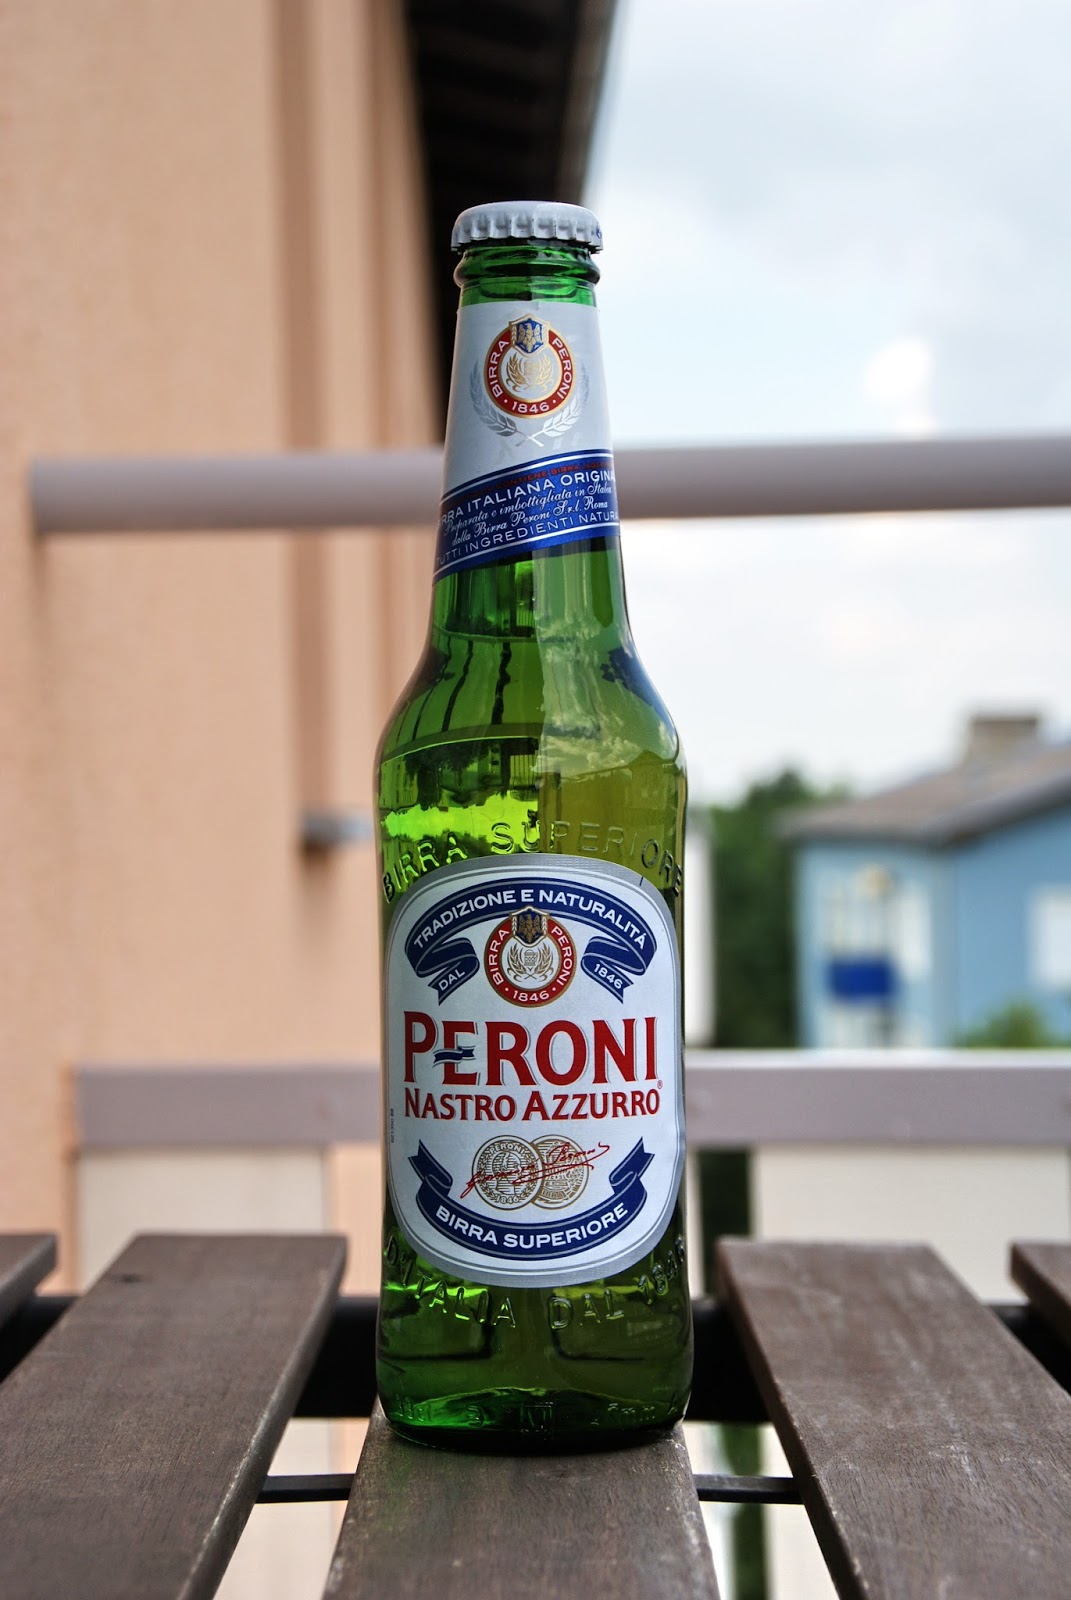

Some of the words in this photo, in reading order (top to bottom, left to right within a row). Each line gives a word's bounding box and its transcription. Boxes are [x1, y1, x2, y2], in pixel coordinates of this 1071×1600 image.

[488, 340, 510, 398] BIRRA
[552, 337, 572, 399] PERONI
[512, 401, 549, 414] 1846
[467, 478, 555, 512] ITALIANA
[499, 488, 572, 515] imbottigliata
[574, 486, 586, 497] in
[465, 516, 574, 553] INGREDIENTI
[473, 521, 508, 538] Birra
[510, 509, 552, 527] Peroni
[584, 495, 608, 511] Roma
[382, 832, 468, 904] BIRRA
[490, 819, 683, 898] SUPERIORE
[413, 889, 517, 949] TRADIZIONE
[521, 889, 534, 903] E
[488, 929, 511, 986] BIRRA
[551, 926, 573, 985] PERONI
[439, 967, 466, 992] DAL
[593, 963, 623, 990] 1846
[513, 990, 549, 1002] 1846
[404, 1011, 659, 1086] PERONI
[404, 1088, 516, 1121] NASTRO
[522, 1089, 661, 1121] AZZURRO
[490, 1143, 525, 1155] PERONI
[496, 1195, 519, 1205] 1846
[435, 1204, 498, 1245] BIRRA
[503, 1202, 628, 1249] SUPERIORE
[549, 1289, 625, 1329] DAL
